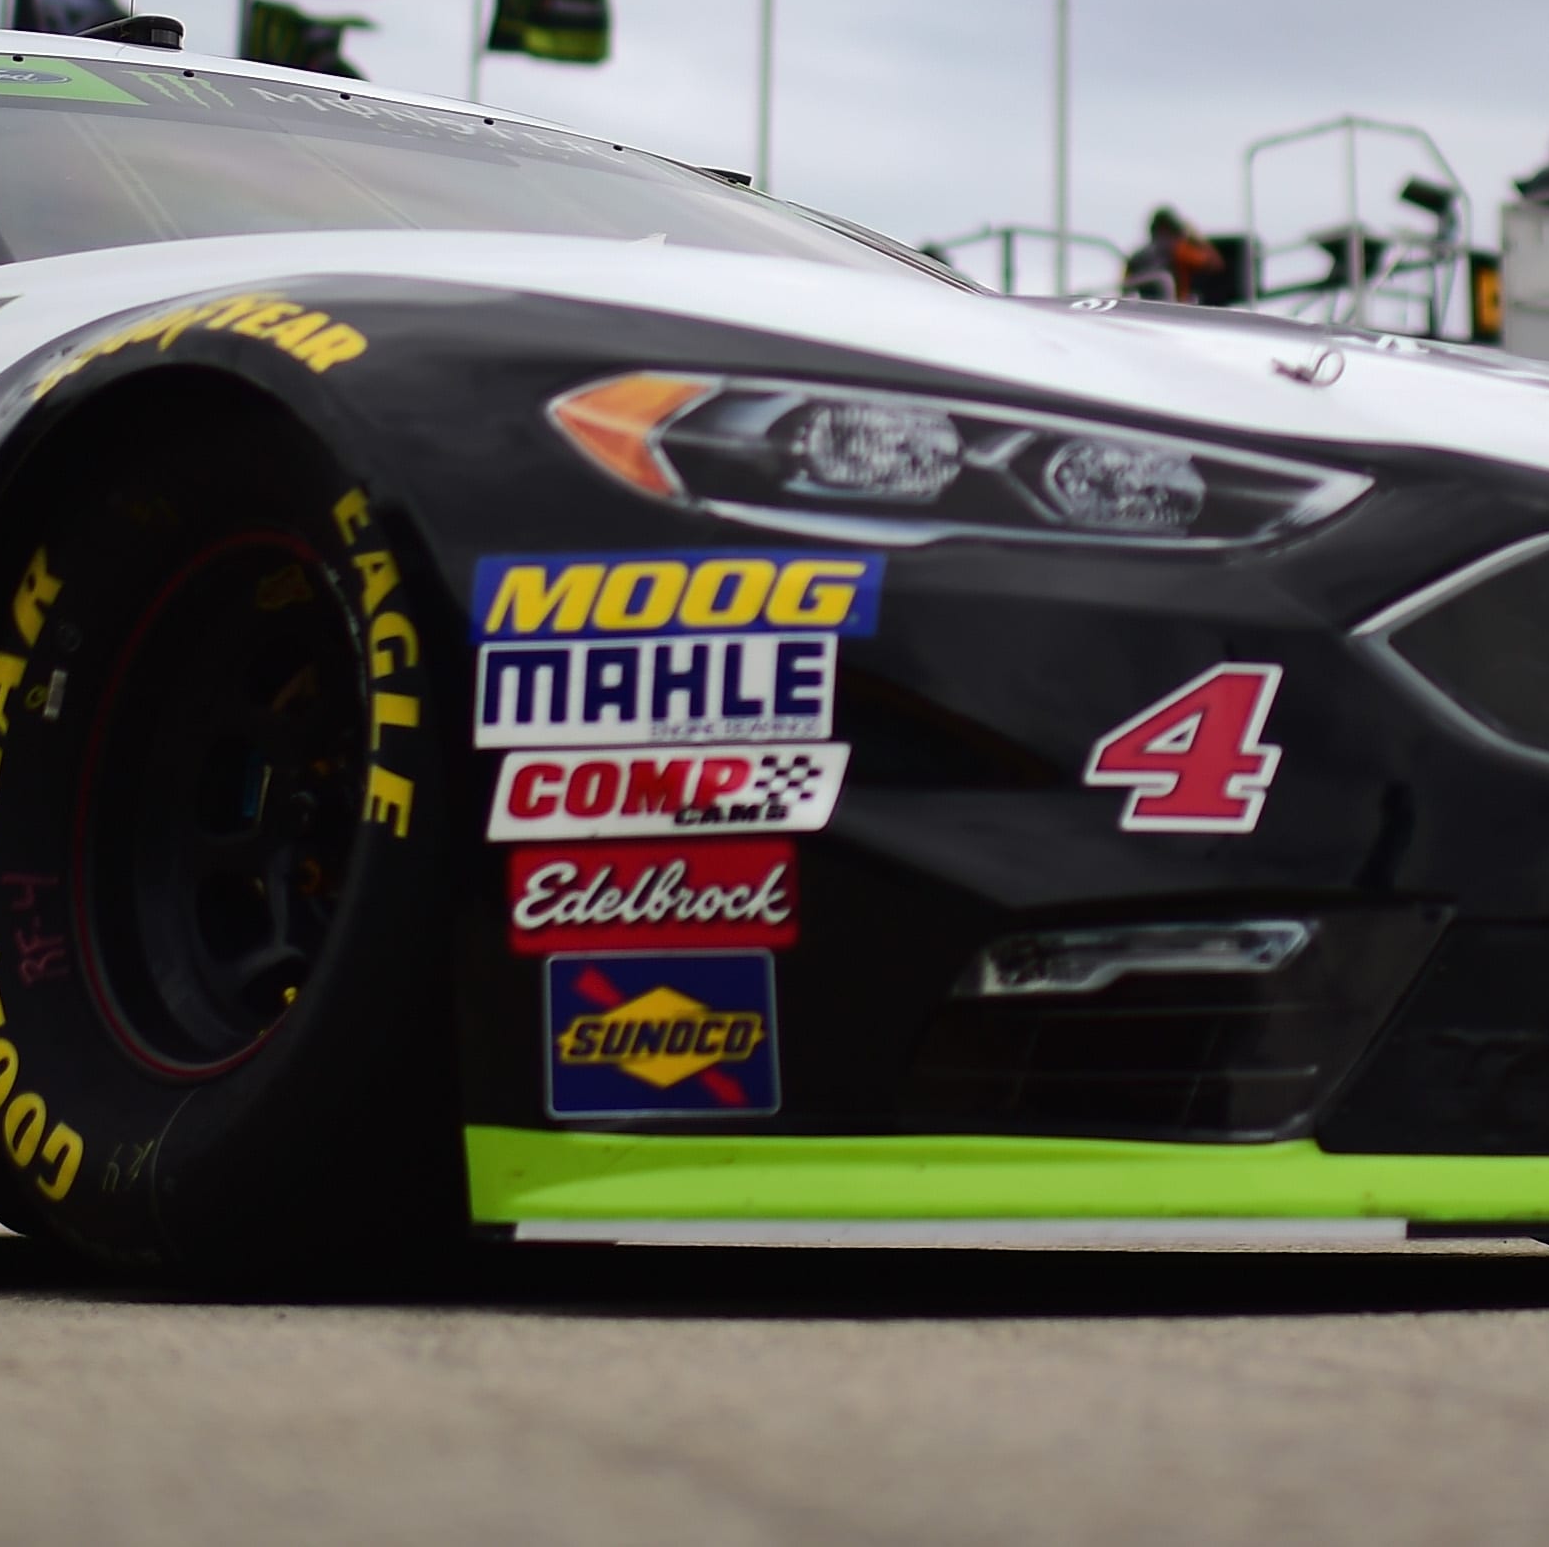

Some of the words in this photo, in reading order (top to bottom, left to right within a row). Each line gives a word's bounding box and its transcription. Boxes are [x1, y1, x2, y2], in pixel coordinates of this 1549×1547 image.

[485, 559, 866, 634] MOOG
[332, 486, 422, 840] EAGLE
[482, 641, 826, 725] MAHLE
[1084, 661, 1284, 834] 4
[507, 757, 751, 820] COMP
[674, 803, 789, 826] CAMS
[512, 858, 792, 930] Edelbrock
[569, 1018, 760, 1057] SUNOCO
